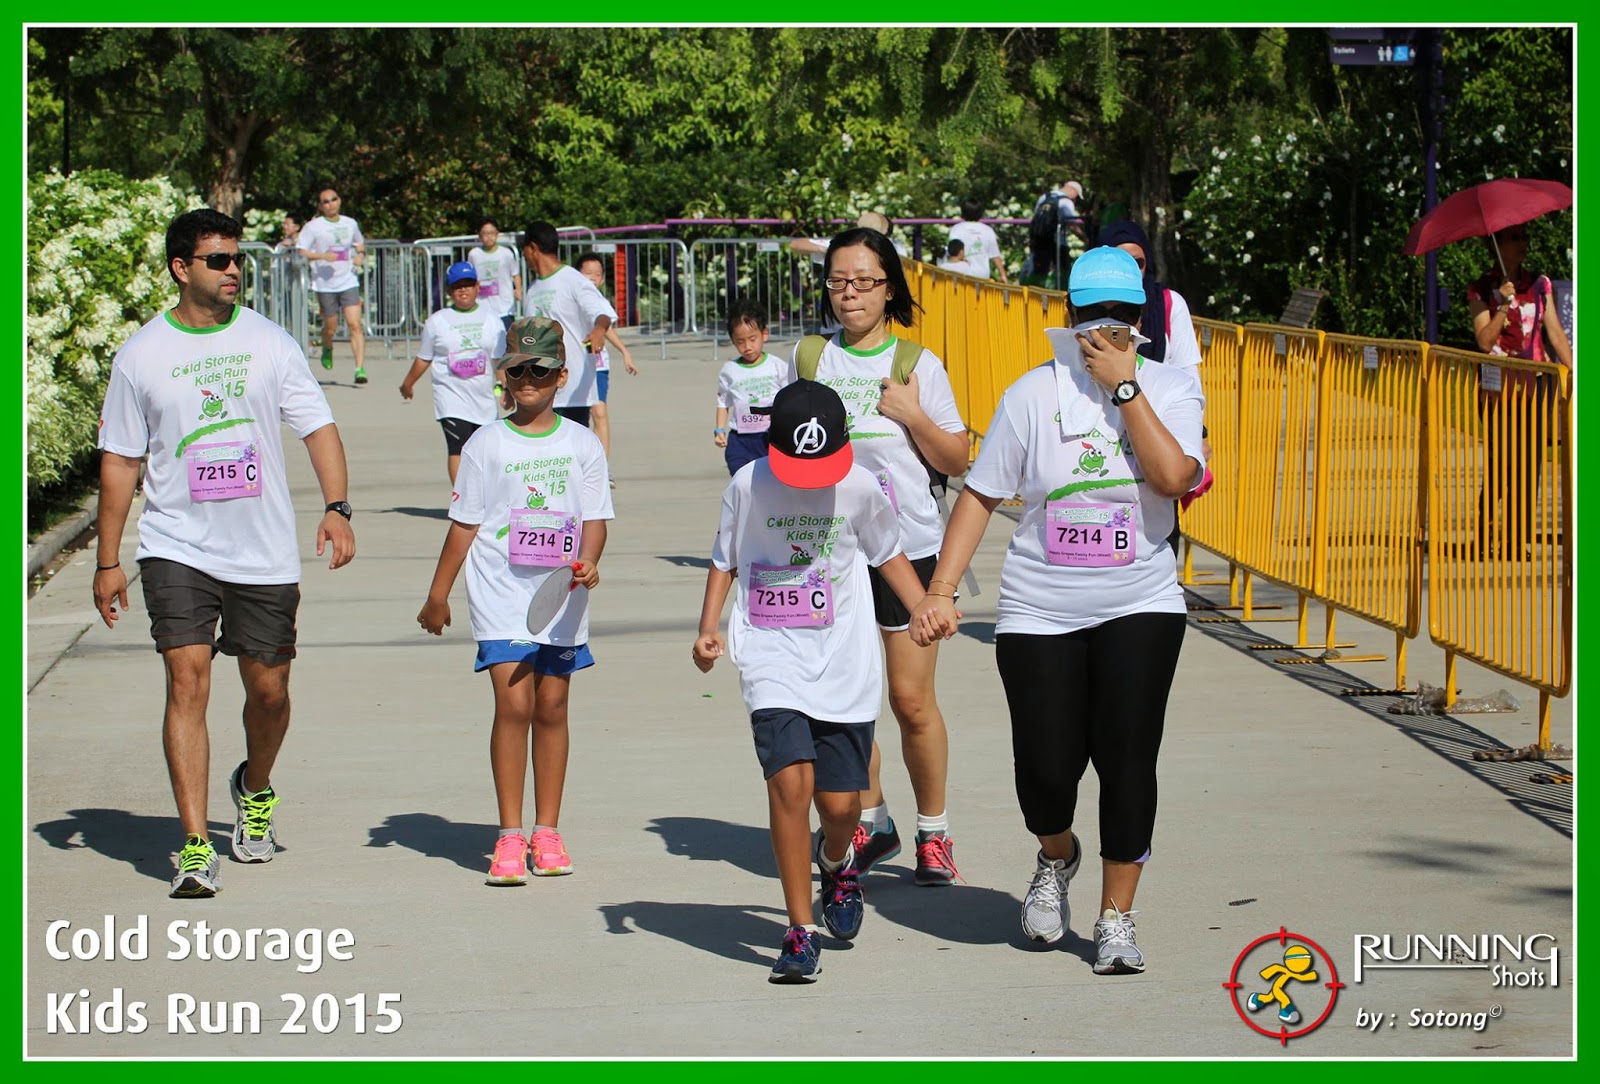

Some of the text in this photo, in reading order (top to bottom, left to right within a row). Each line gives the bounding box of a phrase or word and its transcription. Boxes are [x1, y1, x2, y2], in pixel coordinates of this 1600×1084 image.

[1333, 46, 1356, 54] Toilets
[205, 354, 252, 369] Storage
[195, 368, 248, 386] Kids Run
[847, 376, 881, 387] Stora
[221, 380, 246, 398] '15
[864, 389, 882, 400] Ru
[742, 414, 764, 423] 6392
[533, 456, 573, 469] Storage
[196, 464, 256, 481] 7215 C
[523, 469, 568, 483] Kids Run
[545, 480, 566, 496] '15
[799, 515, 845, 527] Storage
[518, 531, 573, 552] 7214 B
[786, 530, 839, 541] Kids Run
[1057, 527, 1128, 549] 7214 B
[756, 589, 825, 609] 7215 C
